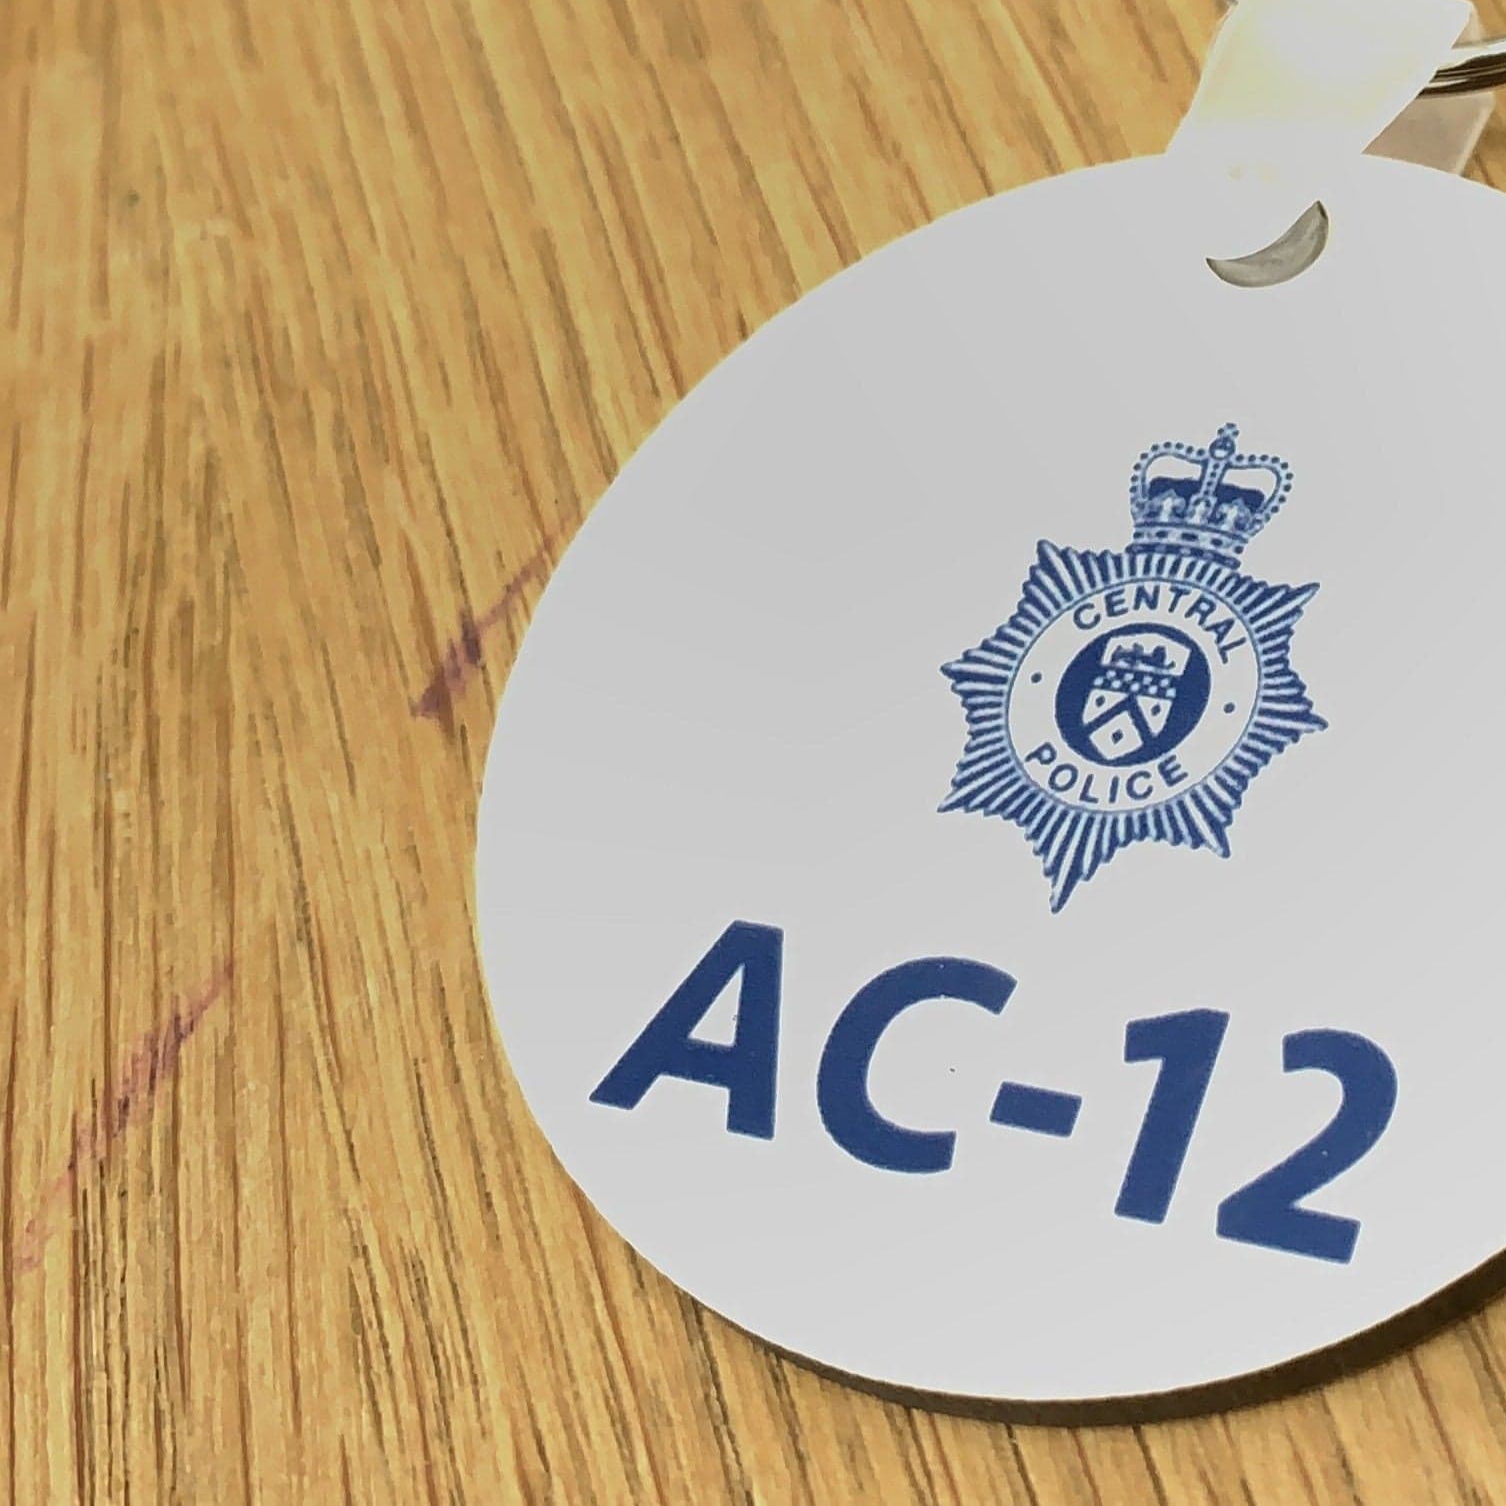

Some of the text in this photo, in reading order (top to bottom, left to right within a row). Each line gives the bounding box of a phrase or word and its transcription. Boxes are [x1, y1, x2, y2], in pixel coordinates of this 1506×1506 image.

[1072, 584, 1248, 665] CENTRAL
[1025, 741, 1188, 804] POLICE
[589, 919, 1399, 1264] AC-12
